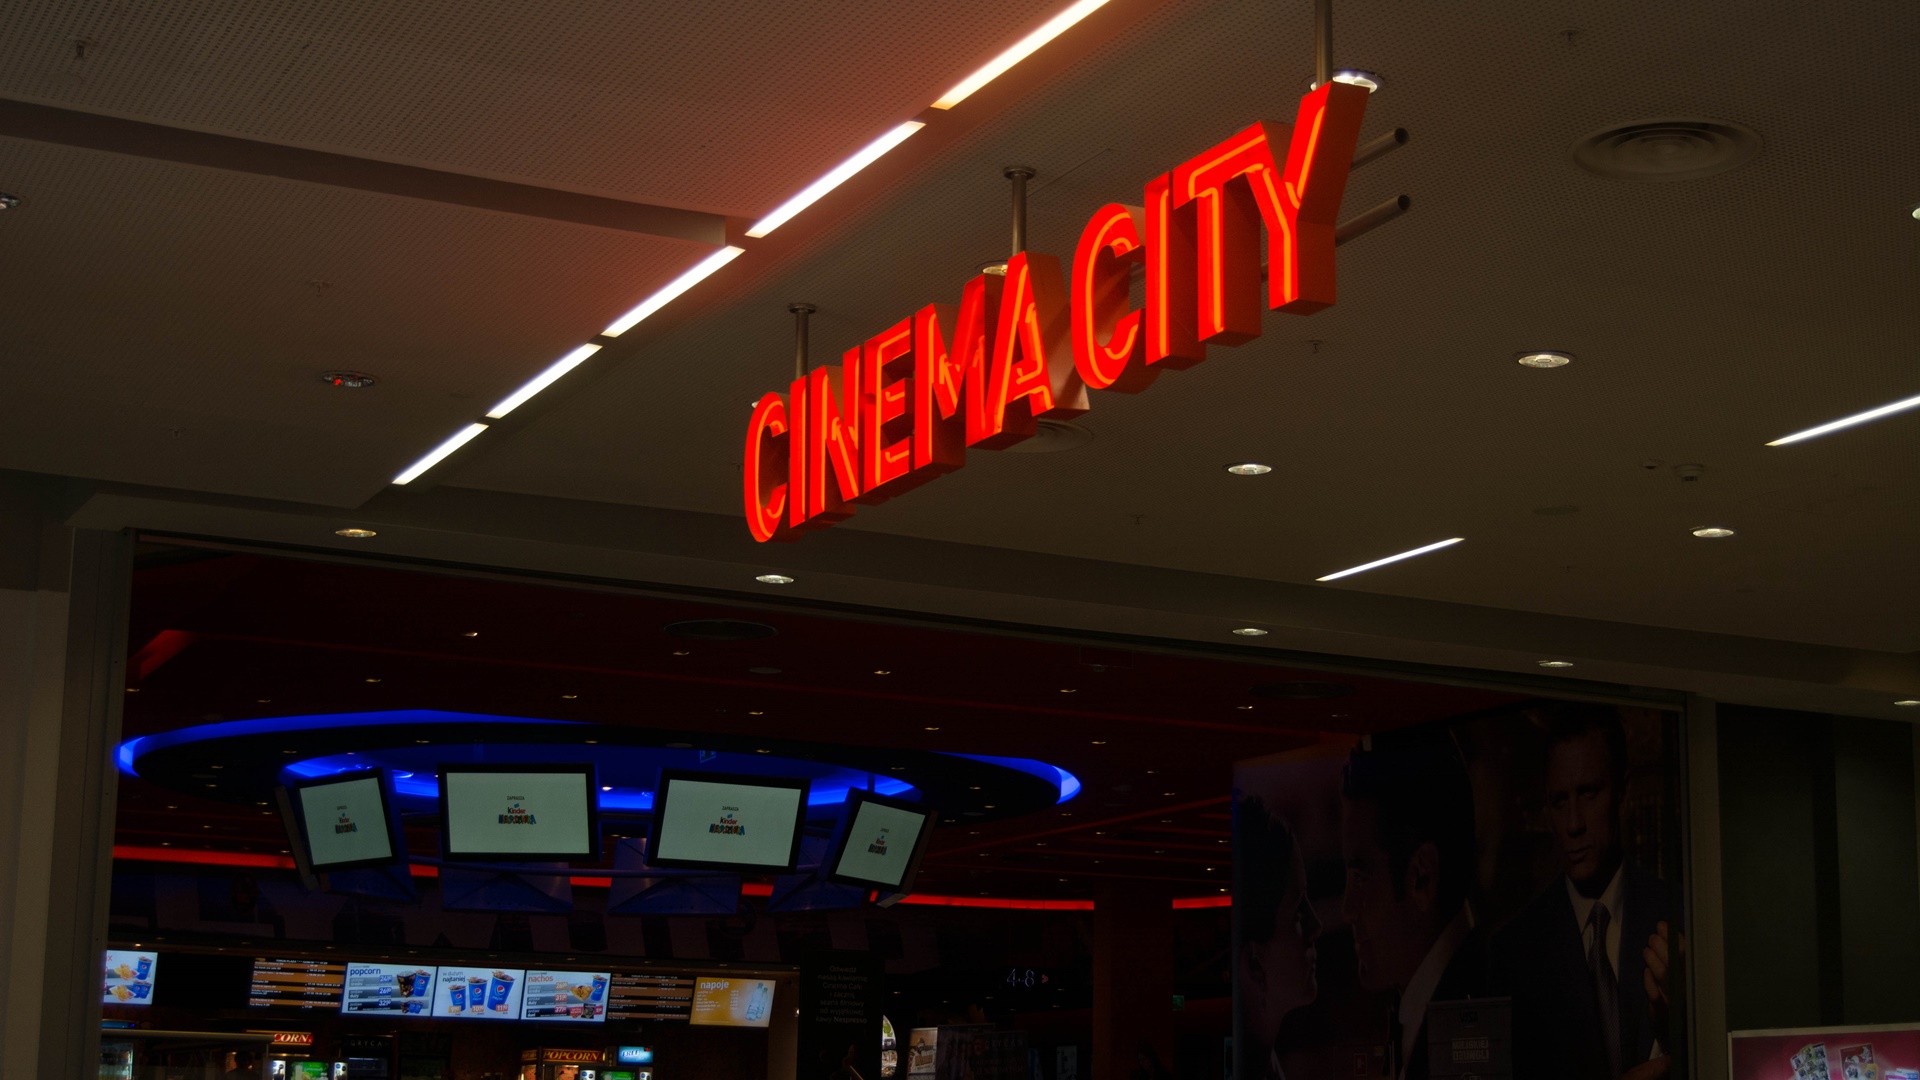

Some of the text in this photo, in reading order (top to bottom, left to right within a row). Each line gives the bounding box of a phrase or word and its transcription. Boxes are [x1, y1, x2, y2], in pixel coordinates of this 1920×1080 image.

[744, 80, 1345, 543] CINEMA CITY
[350, 968, 381, 976] popcorn
[528, 974, 553, 982] nachos
[700, 980, 729, 990] napoje
[833, 1016, 868, 1024] Nespresso
[543, 1050, 600, 1061] POPCORN
